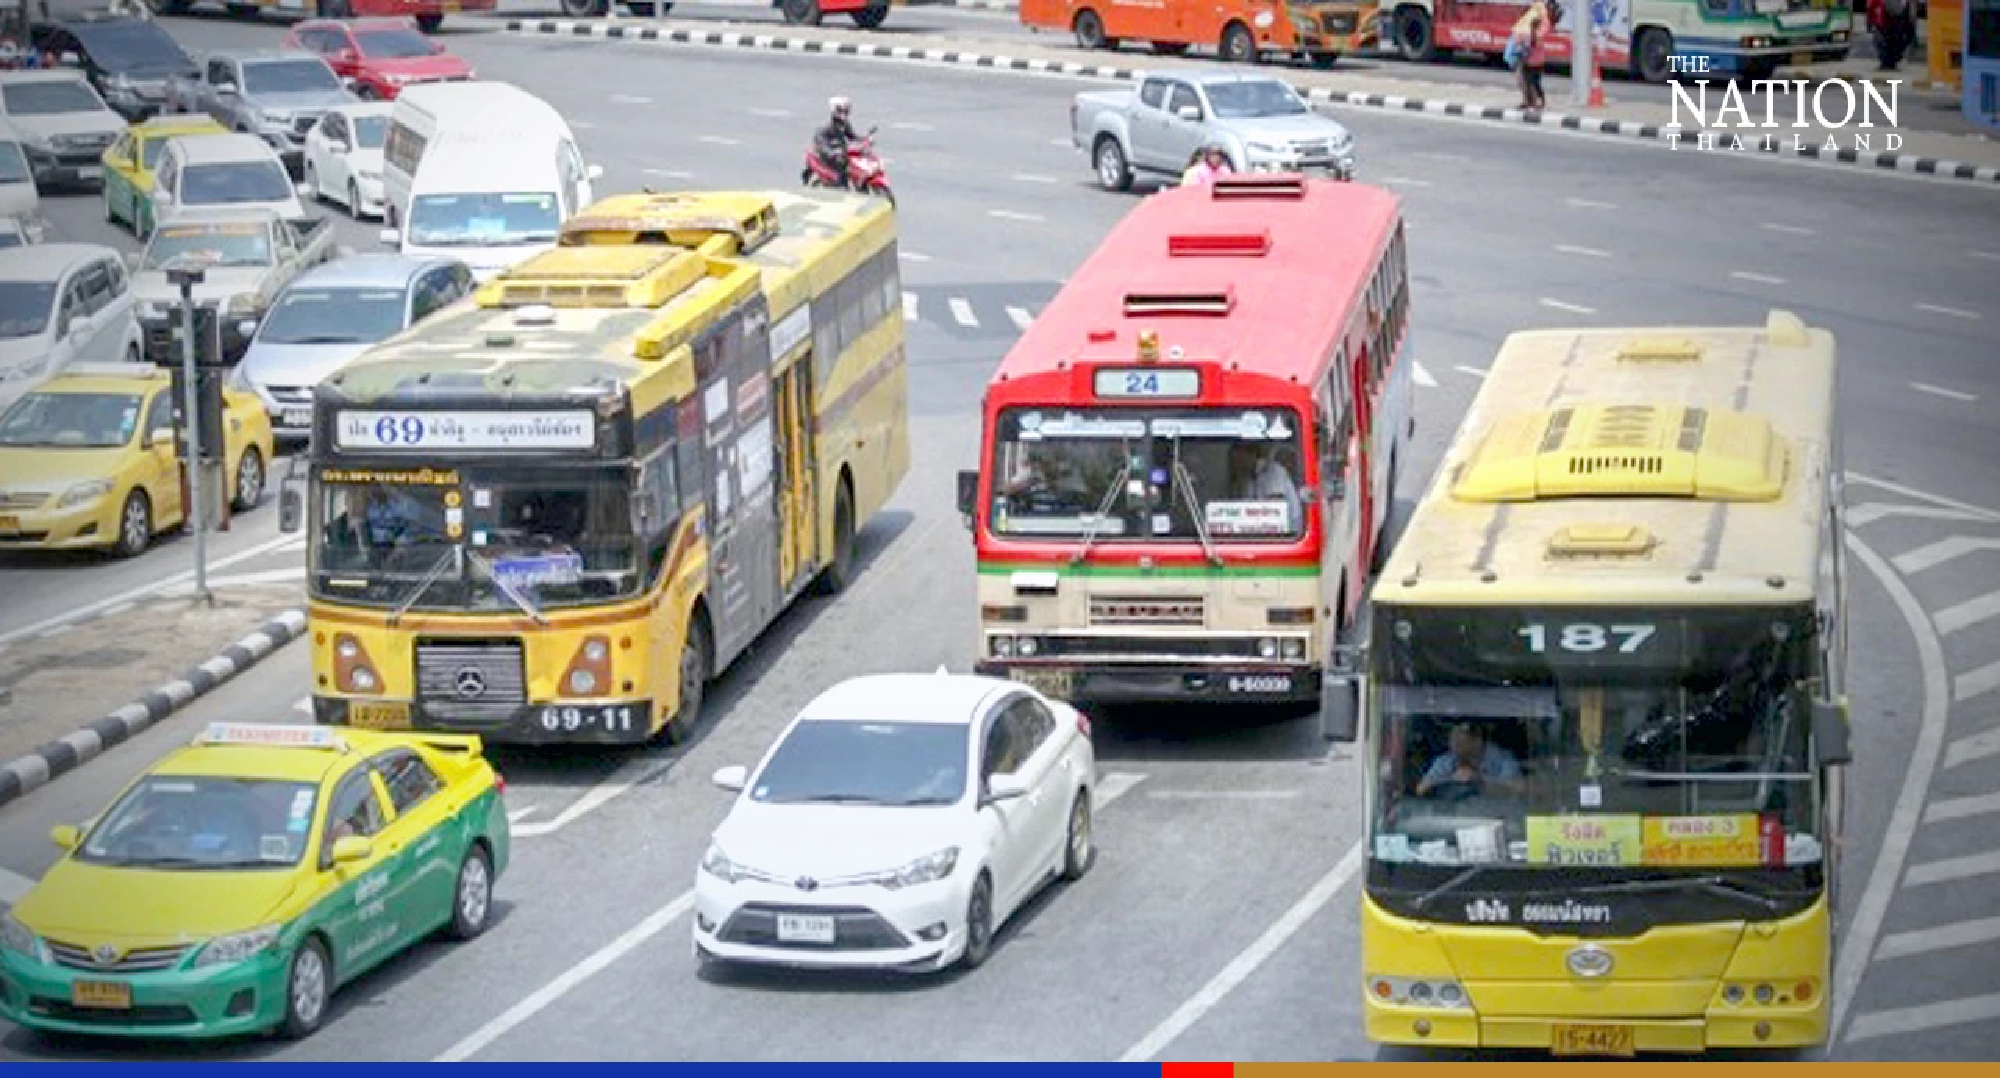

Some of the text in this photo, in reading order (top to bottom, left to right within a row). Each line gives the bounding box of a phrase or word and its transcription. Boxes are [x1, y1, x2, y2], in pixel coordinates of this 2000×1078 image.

[1125, 371, 1159, 393] 24
[374, 415, 425, 445] 69
[1517, 622, 1656, 652] 187
[541, 708, 632, 731] 69-11
